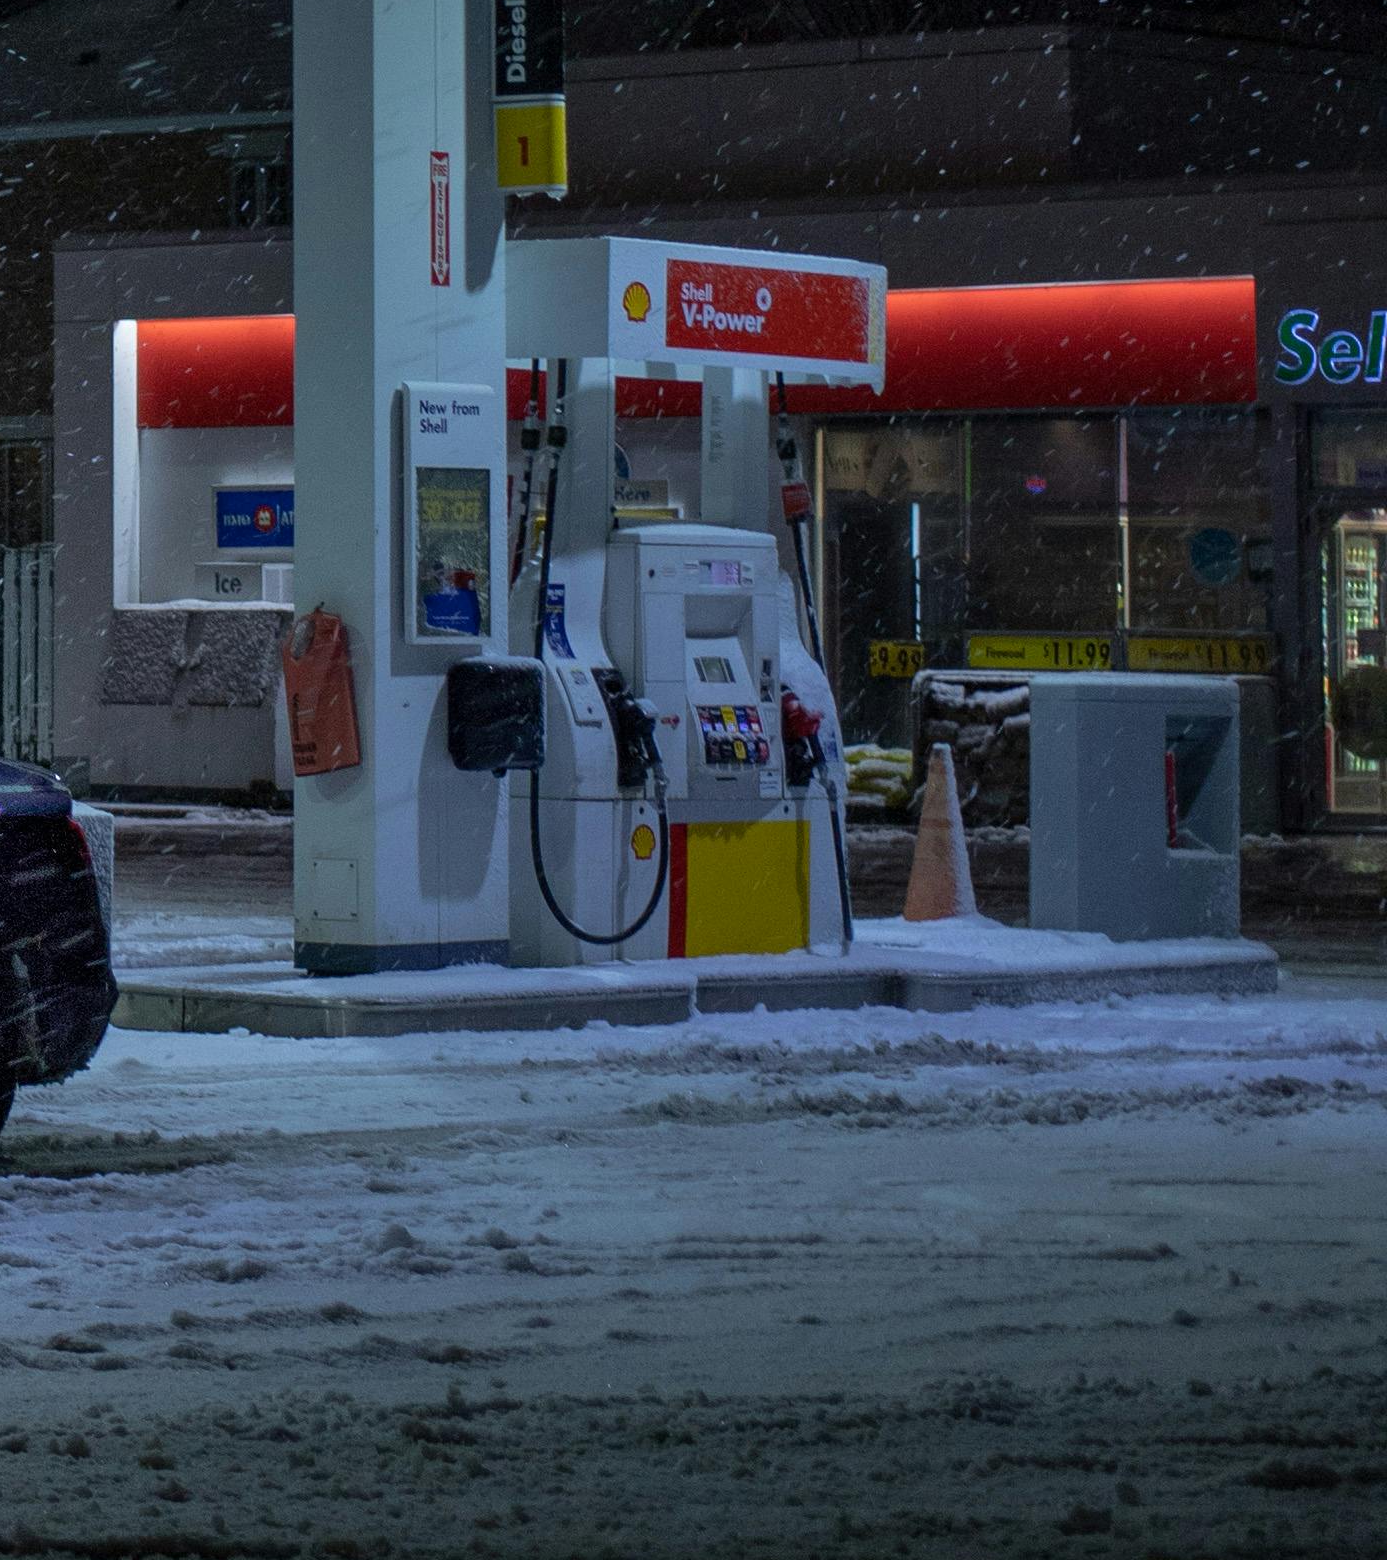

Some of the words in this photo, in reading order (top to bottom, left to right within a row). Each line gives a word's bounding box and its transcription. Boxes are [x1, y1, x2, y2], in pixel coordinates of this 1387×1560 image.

[517, 136, 529, 167] 1
[680, 282, 714, 302] Shell
[681, 302, 766, 334] V-Power
[1275, 309, 1387, 385] Sel
[420, 400, 447, 414] New
[452, 401, 481, 416] from
[420, 419, 448, 433] Shell
[215, 572, 242, 593] Ice
